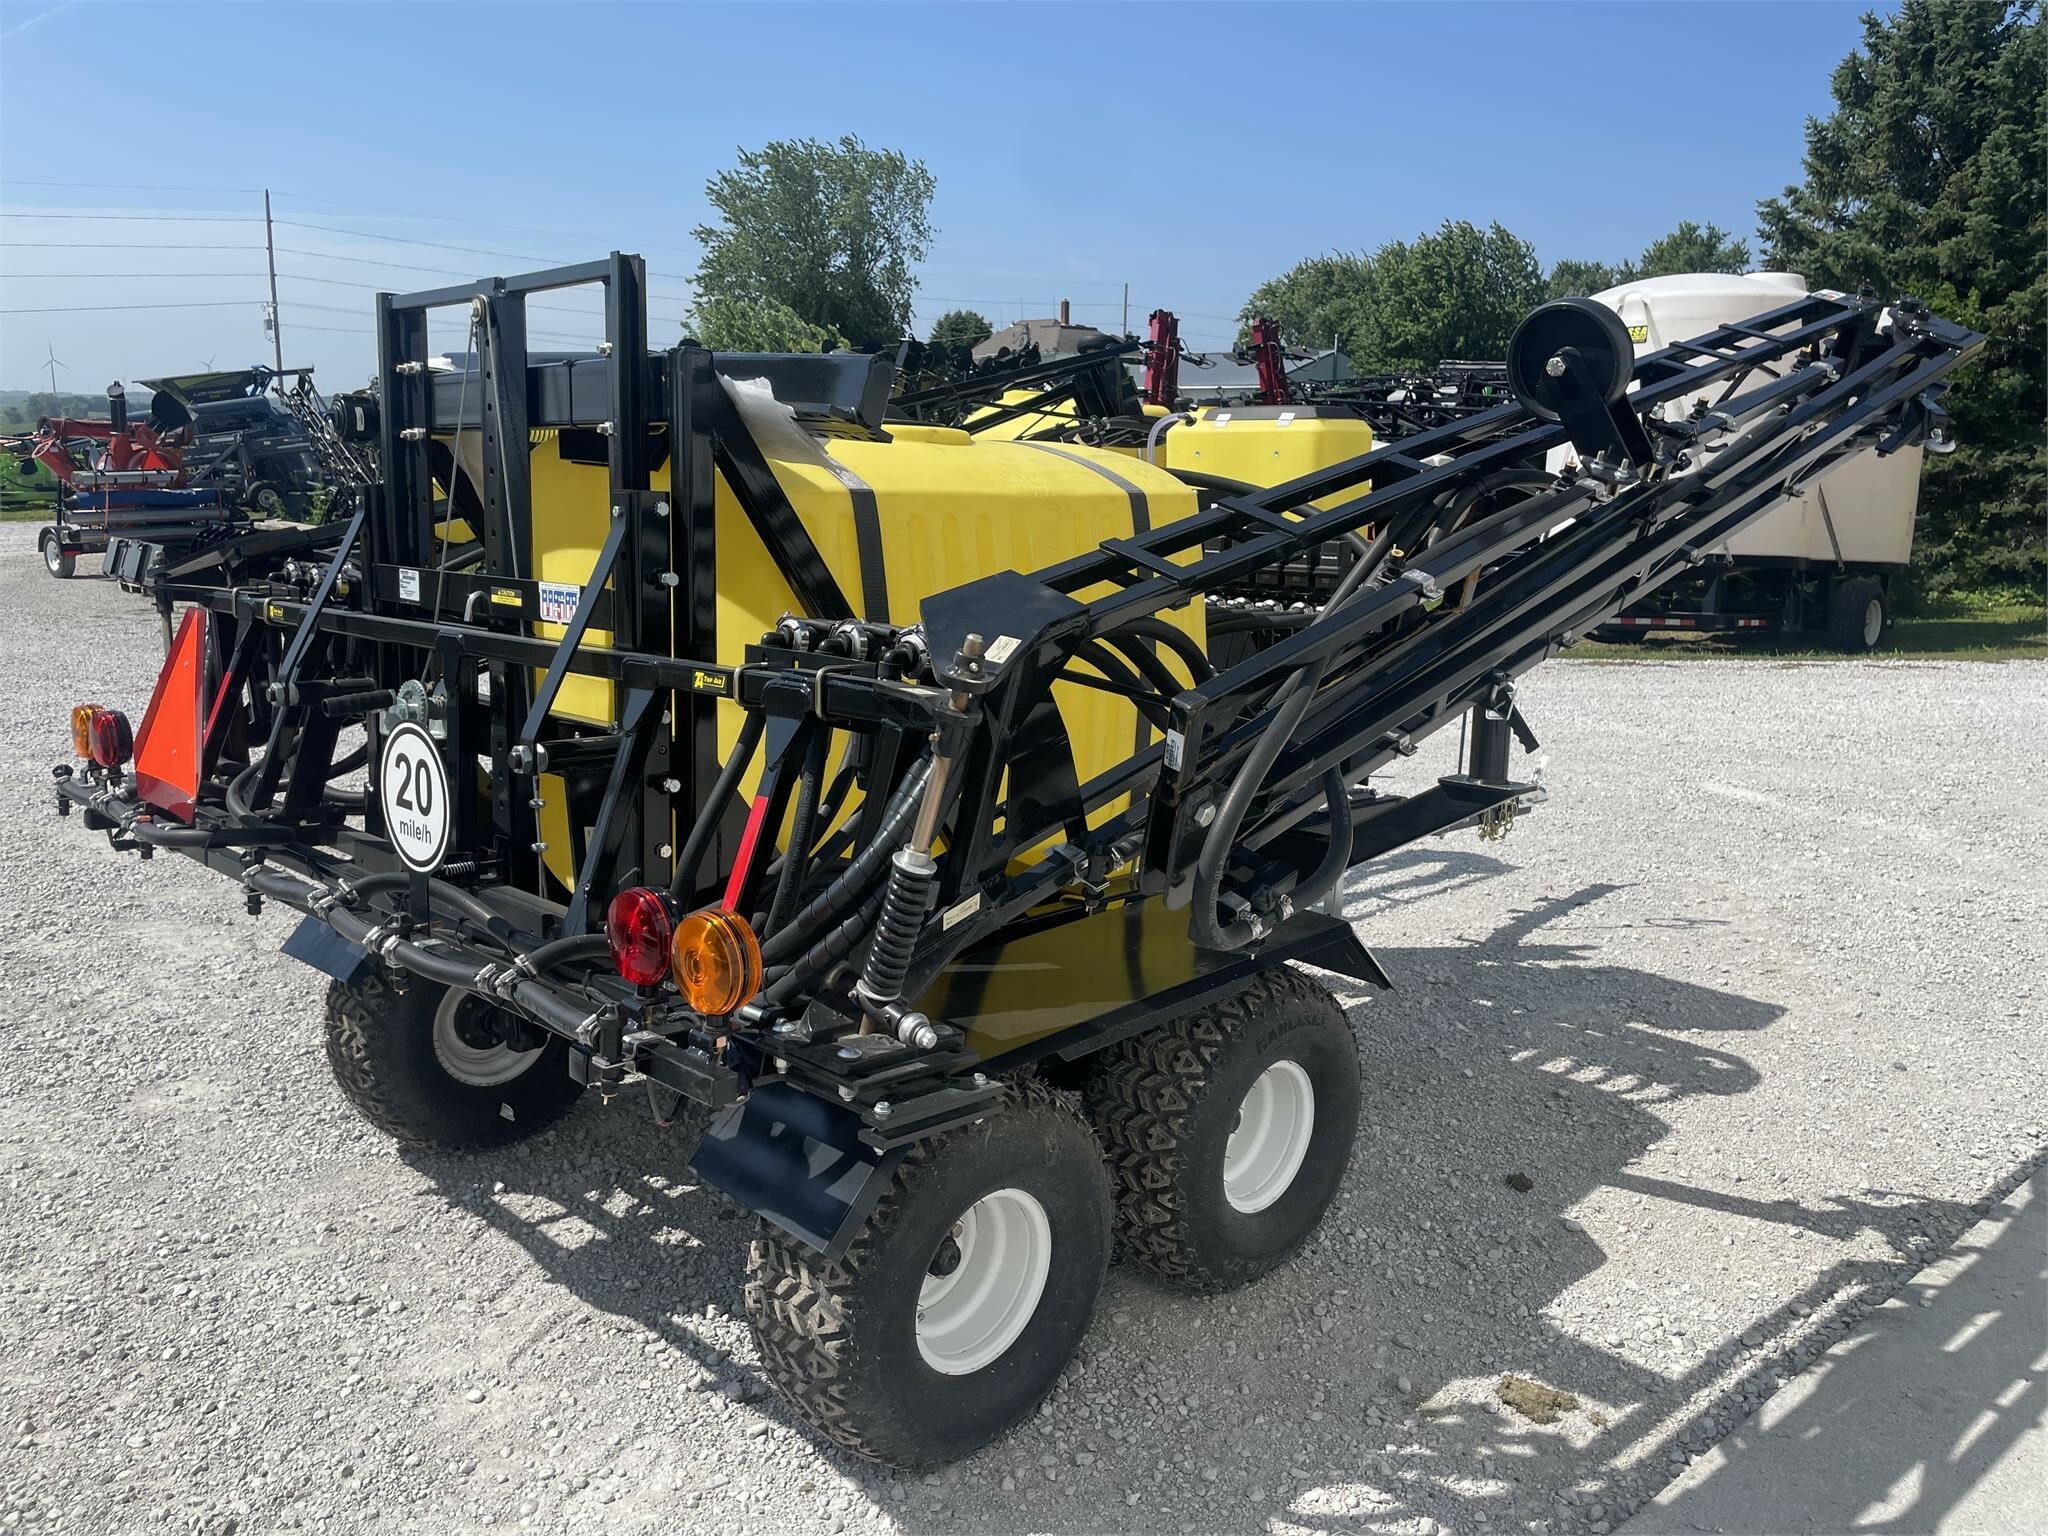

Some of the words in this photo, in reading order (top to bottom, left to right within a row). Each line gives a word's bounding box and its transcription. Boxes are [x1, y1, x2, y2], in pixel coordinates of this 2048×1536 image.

[541, 589, 578, 620] USA
[395, 752, 432, 817] 20
[399, 819, 432, 845] mile/h
